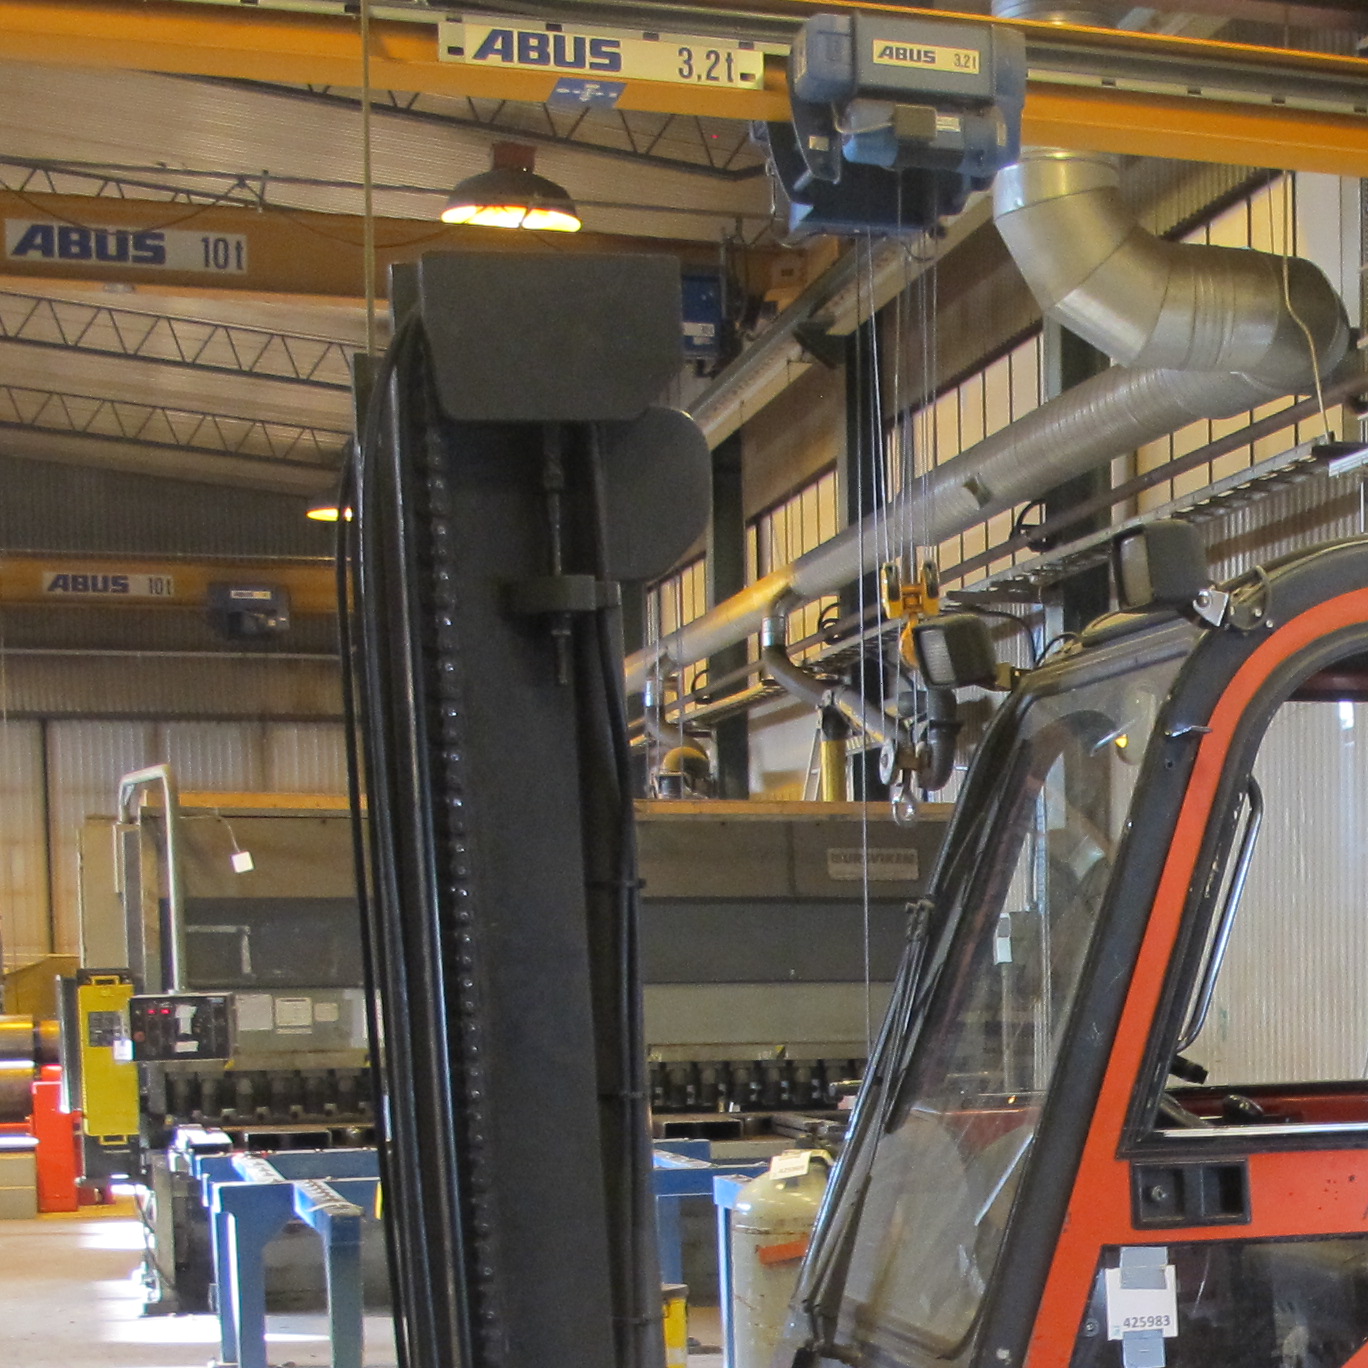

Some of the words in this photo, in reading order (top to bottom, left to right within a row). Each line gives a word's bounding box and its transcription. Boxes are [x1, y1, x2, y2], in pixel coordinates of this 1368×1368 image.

[472, 29, 623, 72] ABUS
[878, 46, 937, 64] ABUS
[11, 224, 166, 265] ABUS
[47, 574, 130, 594] ABUS
[1123, 1315, 1170, 1328] 425983
